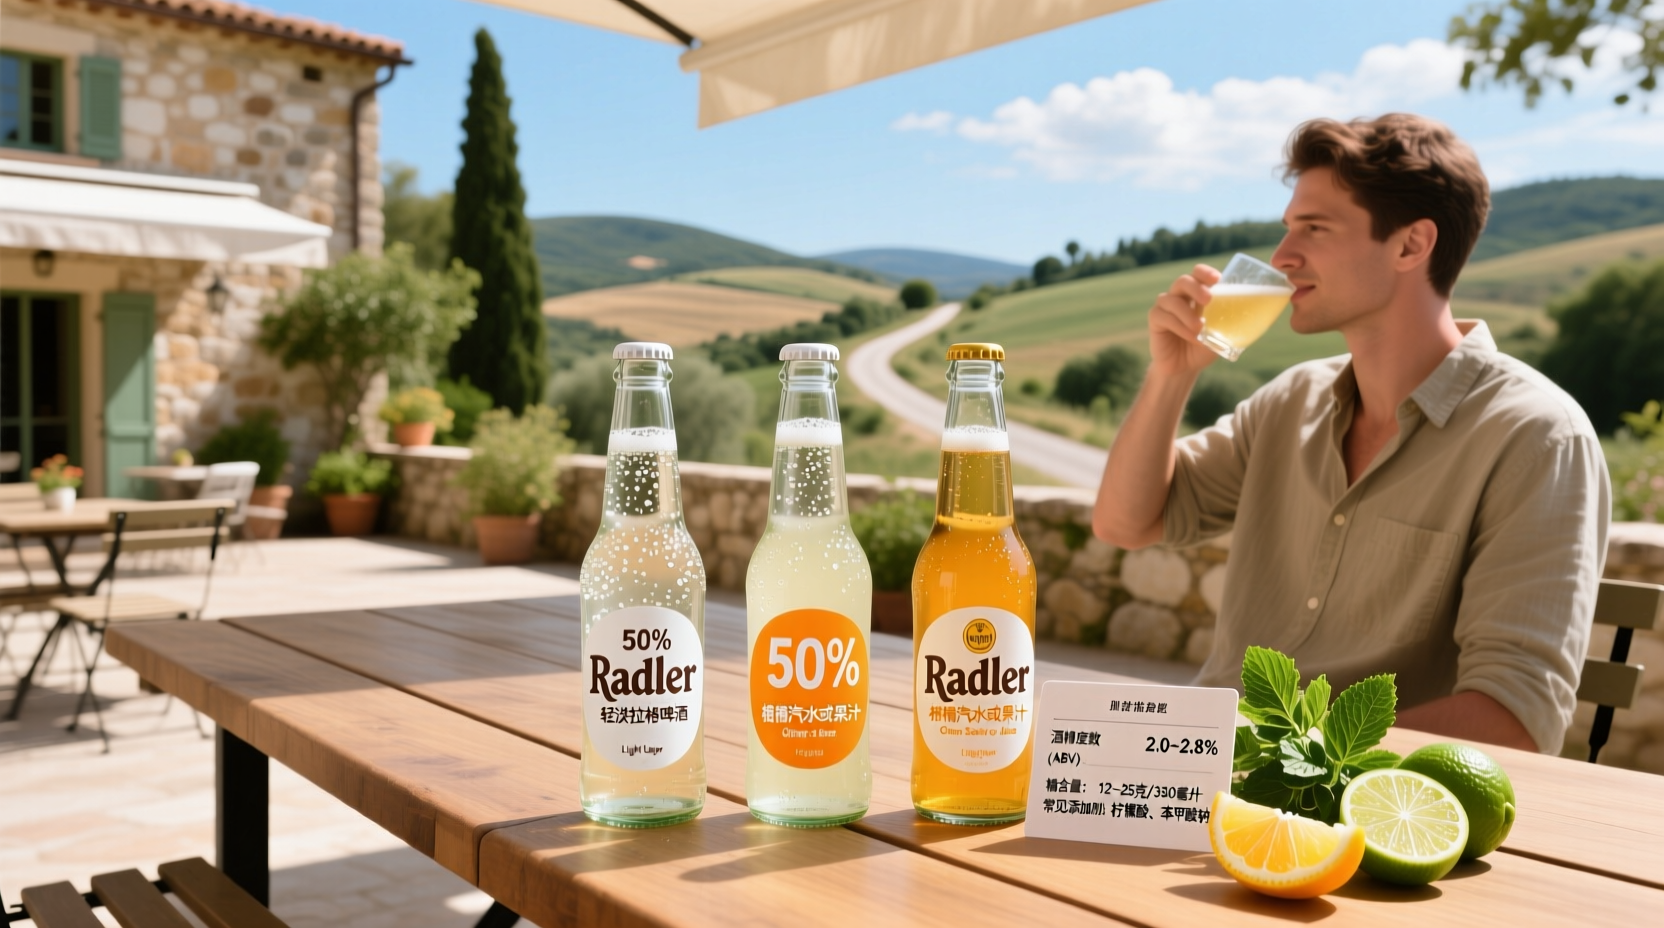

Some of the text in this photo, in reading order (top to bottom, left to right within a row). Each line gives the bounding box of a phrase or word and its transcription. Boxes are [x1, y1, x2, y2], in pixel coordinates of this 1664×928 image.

[622, 628, 672, 651] 50%
[589, 654, 697, 702] Radler
[767, 637, 860, 690] 50%
[924, 655, 1030, 702] Radler
[1047, 752, 1081, 767] (ABV)
